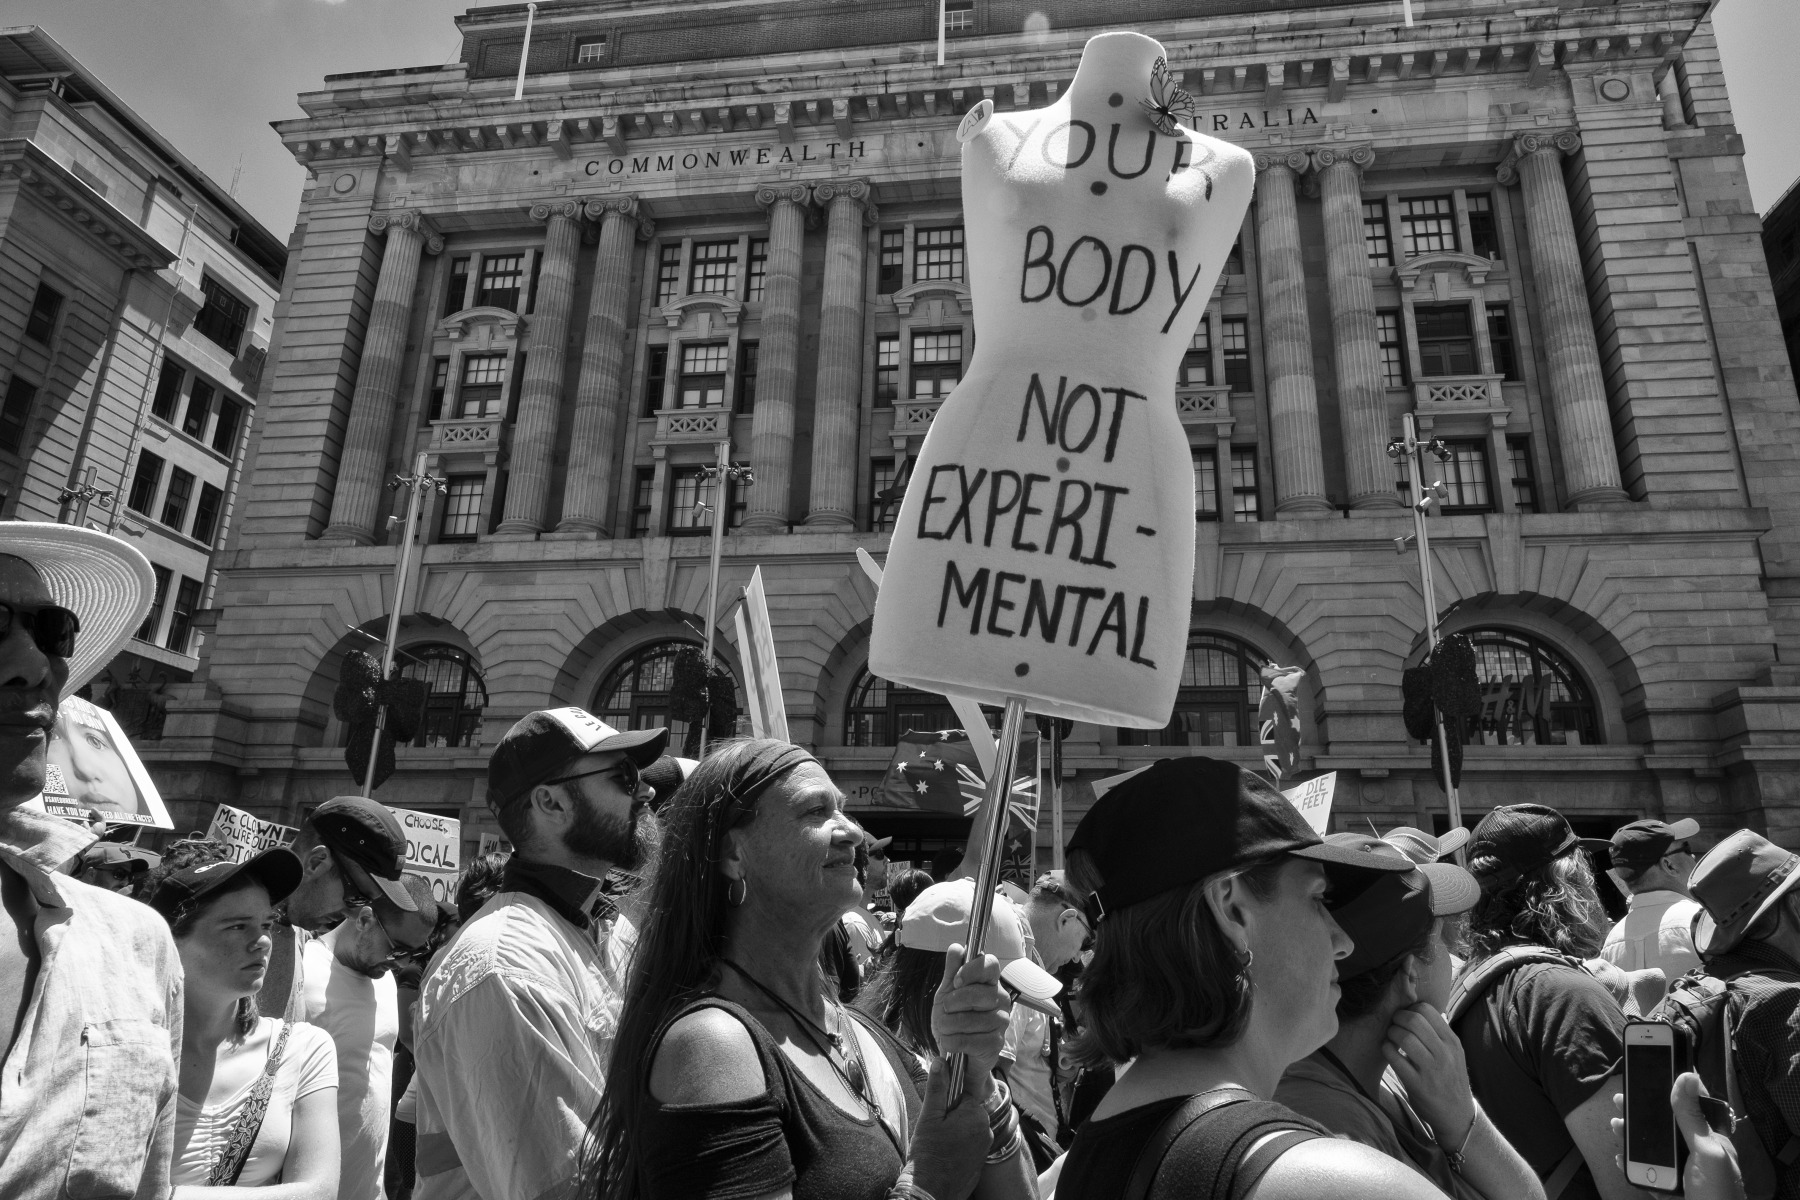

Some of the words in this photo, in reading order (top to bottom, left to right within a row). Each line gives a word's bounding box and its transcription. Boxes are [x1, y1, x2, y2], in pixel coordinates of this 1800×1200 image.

[1193, 107, 1319, 132] TRALIA
[585, 140, 865, 176] COMMONWEALTH
[1002, 119, 1216, 202] YOUR
[1020, 225, 1202, 334] BODY
[1016, 373, 1147, 463] NOT
[937, 560, 1157, 670] MENTAL
[1481, 673, 1552, 720] H&M
[1306, 776, 1330, 796] DIE
[65, 807, 79, 816] YOU
[1302, 791, 1328, 810] FEET
[240, 814, 283, 841] CLOWN
[404, 814, 444, 832] CHOOSE
[406, 840, 455, 868] DICAL
